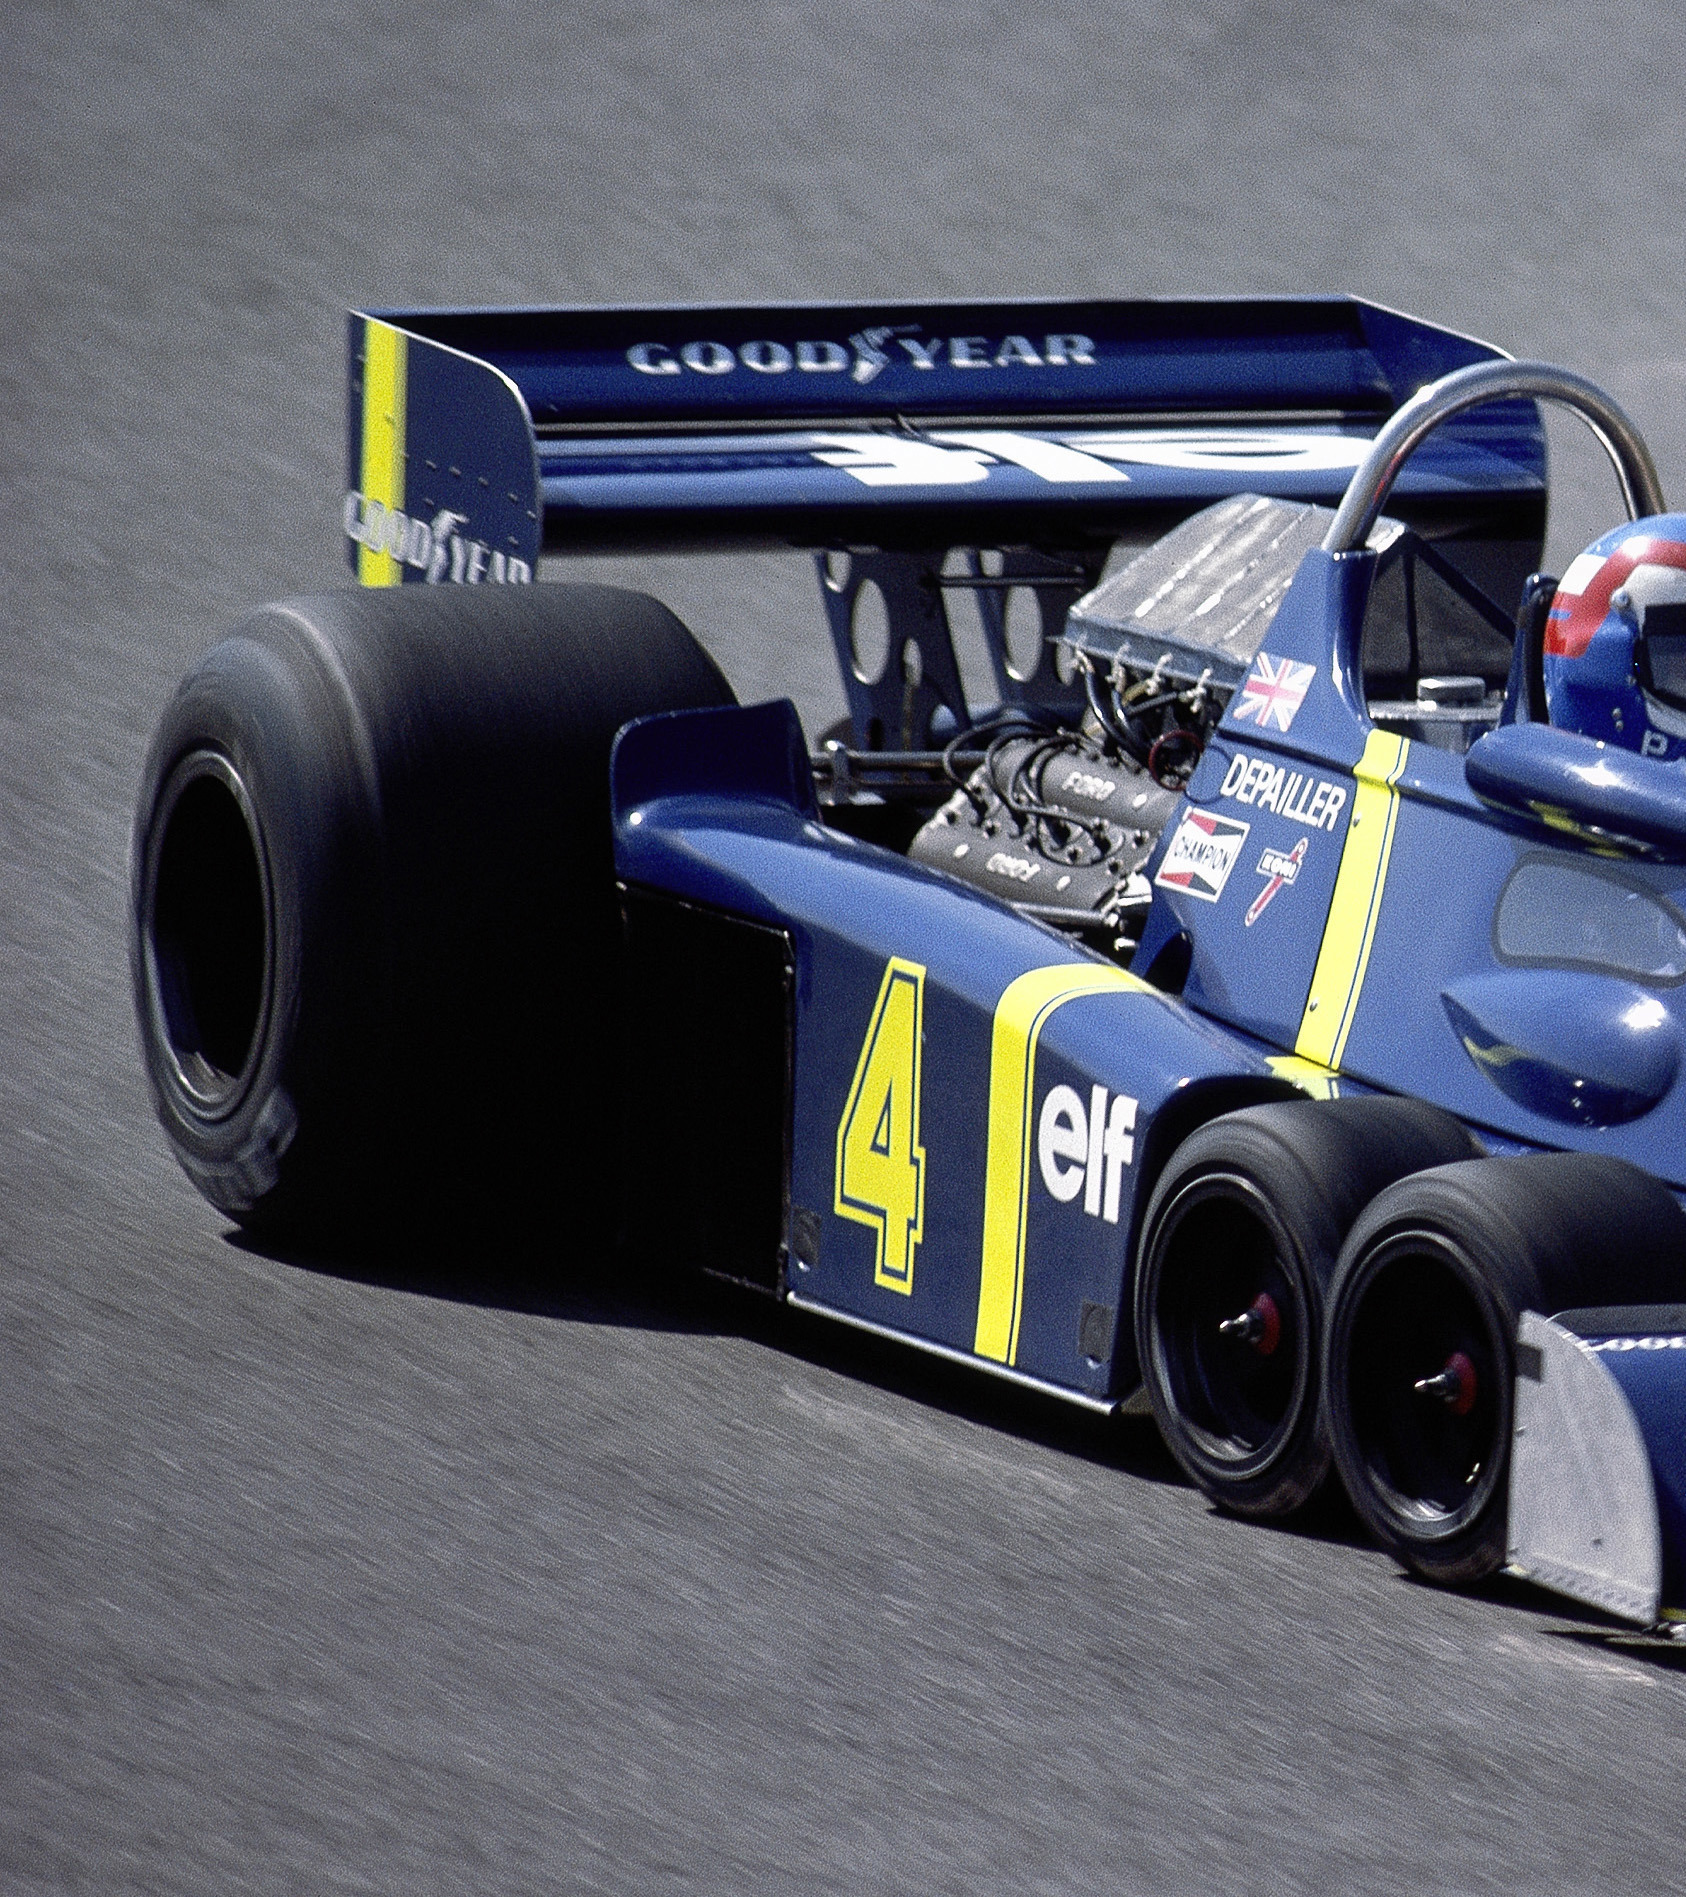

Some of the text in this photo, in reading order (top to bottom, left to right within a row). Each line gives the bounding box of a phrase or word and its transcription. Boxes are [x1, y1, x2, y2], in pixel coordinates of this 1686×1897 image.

[626, 330, 1097, 379] GOODYEAR
[1062, 771, 1116, 800] FORD
[1220, 753, 1347, 832] DEPAILLER
[1174, 835, 1231, 872] CHAMPION
[1261, 853, 1298, 877] KONI
[834, 956, 927, 1296] 4
[1038, 1084, 1139, 1224] elf
